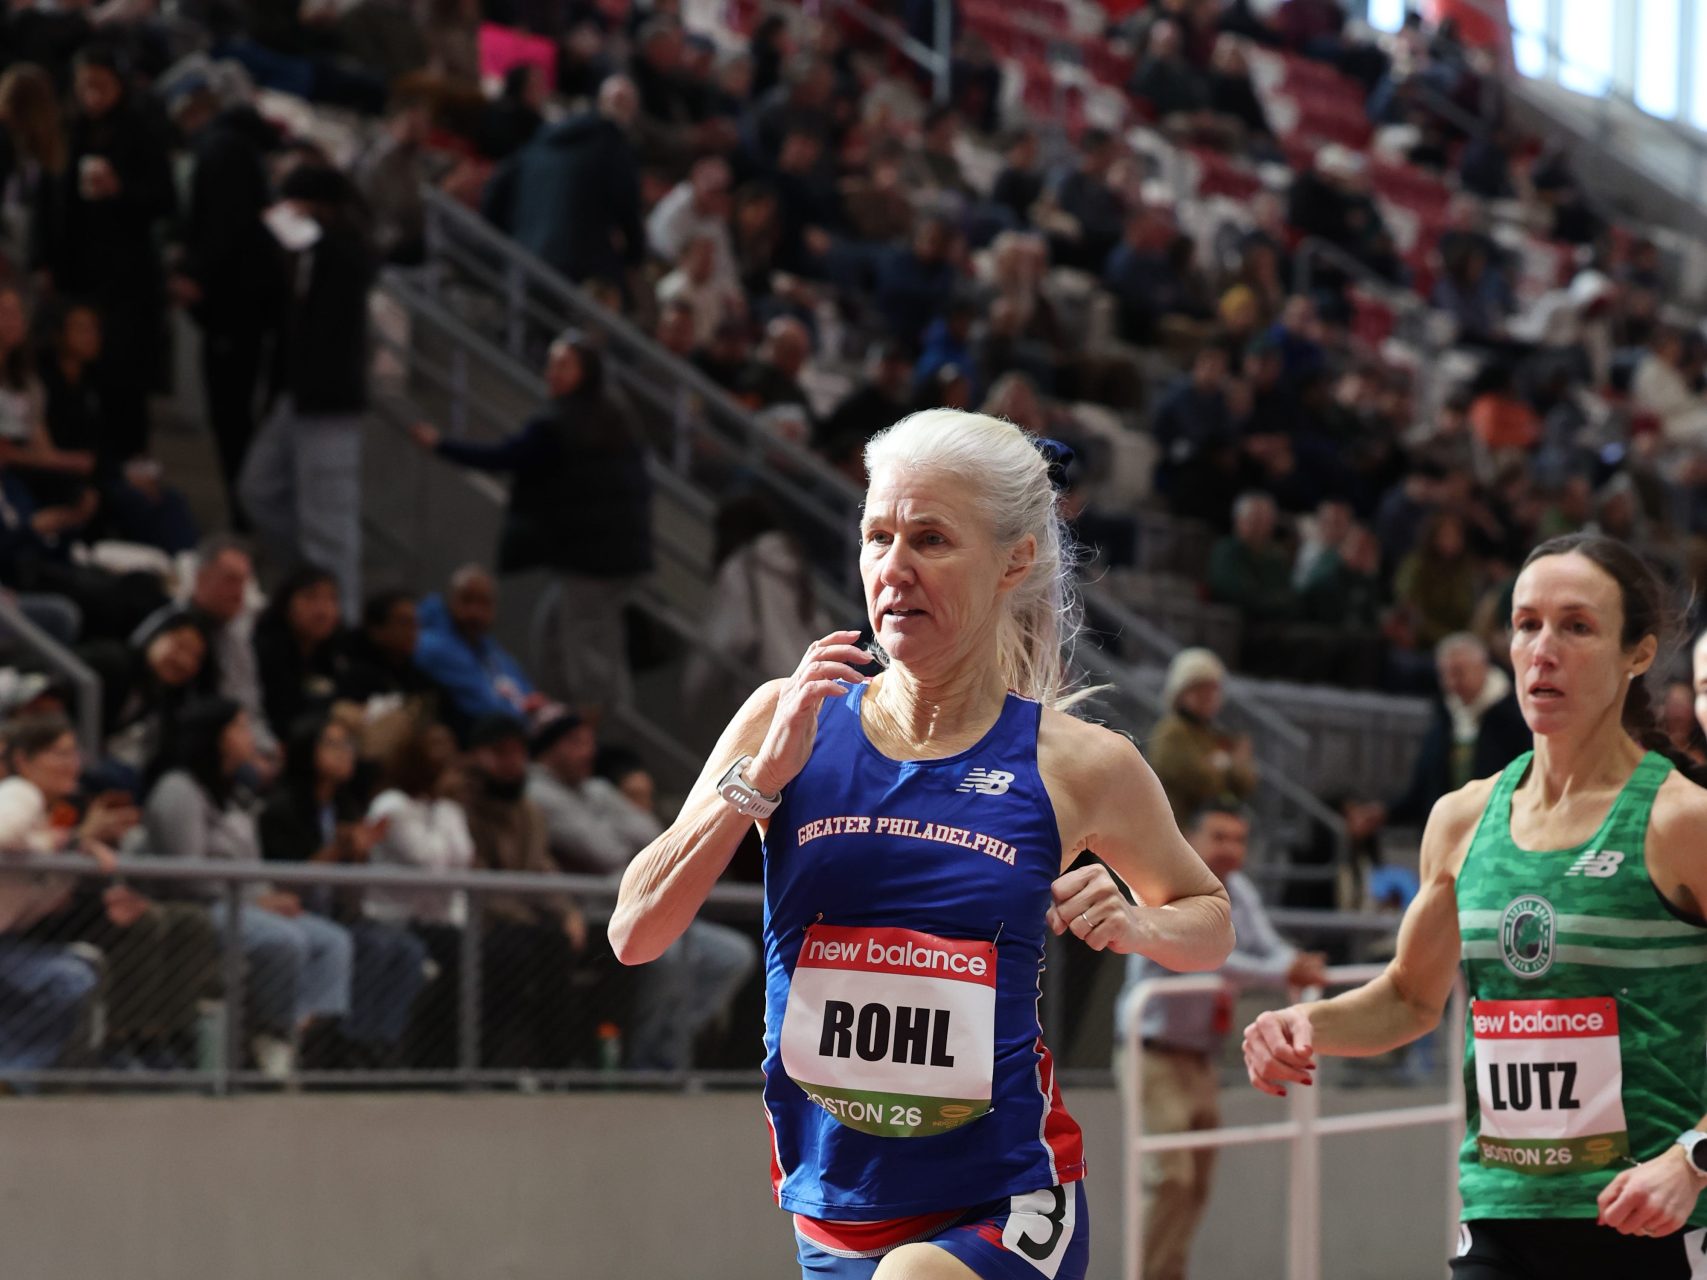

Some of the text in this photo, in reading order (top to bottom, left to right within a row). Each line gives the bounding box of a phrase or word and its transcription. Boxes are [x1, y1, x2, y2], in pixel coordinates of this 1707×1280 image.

[798, 816, 1018, 866] GREATER PHILADELPHIA
[808, 938, 987, 977] new balance
[819, 1000, 954, 1067] ROHL
[1509, 1010, 1603, 1033] balance
[1489, 1061, 1581, 1111] LUTZ
[808, 1092, 922, 1127] OSTON 26
[1482, 1142, 1540, 1165] BOSTON
[1545, 1147, 1572, 1165] 26
[1016, 1184, 1066, 1260] 3
